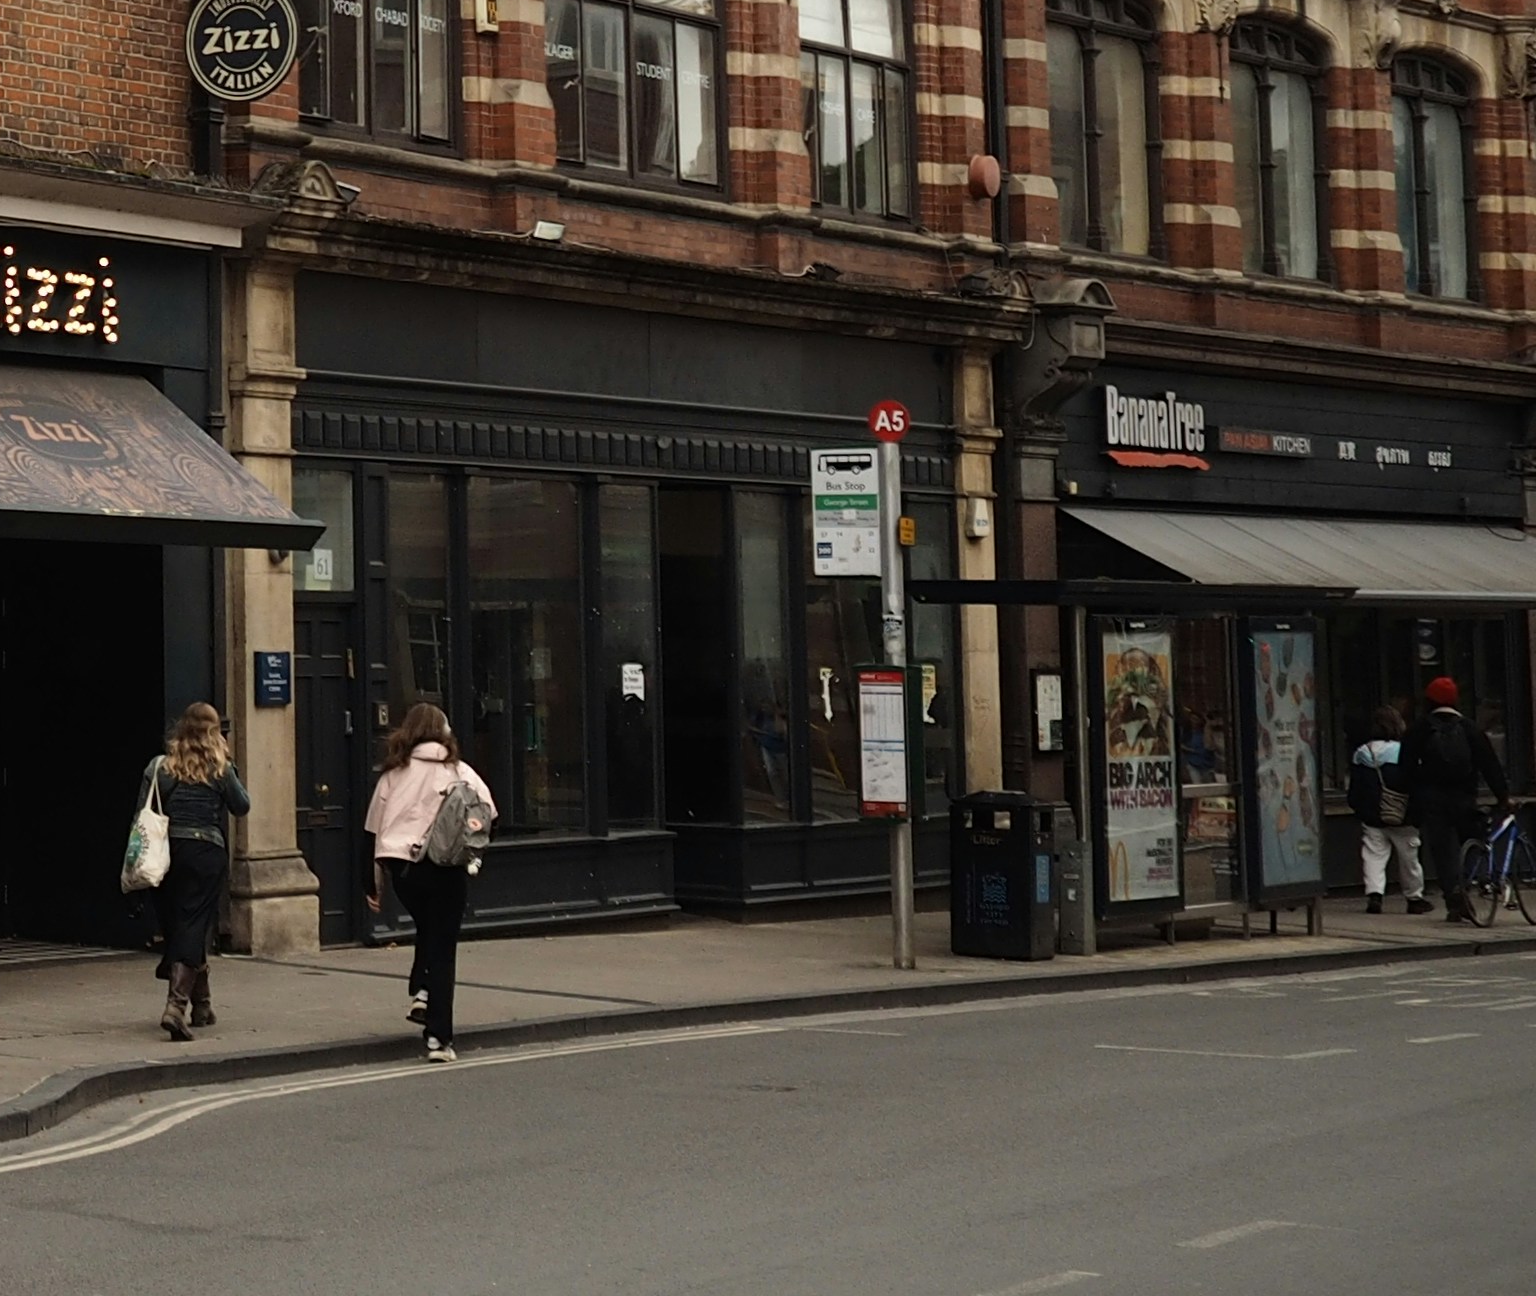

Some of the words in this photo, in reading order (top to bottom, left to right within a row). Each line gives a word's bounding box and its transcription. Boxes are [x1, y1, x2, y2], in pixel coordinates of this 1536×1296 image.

[201, 21, 280, 55] Zizzi
[209, 60, 274, 90] ITALIAN
[635, 61, 672, 81] STUDENT
[8, 413, 103, 445] Zizzi
[874, 410, 905, 432] A5
[1105, 384, 1206, 452] BananaTree
[1272, 435, 1312, 455] KITCHEN
[825, 481, 842, 491] Bus
[844, 481, 866, 493] Stop
[316, 557, 329, 576] 61
[1108, 761, 1135, 789] BIG
[1136, 760, 1173, 789] ARCH
[1110, 788, 1139, 810] WITH
[1139, 788, 1174, 809] BACON
